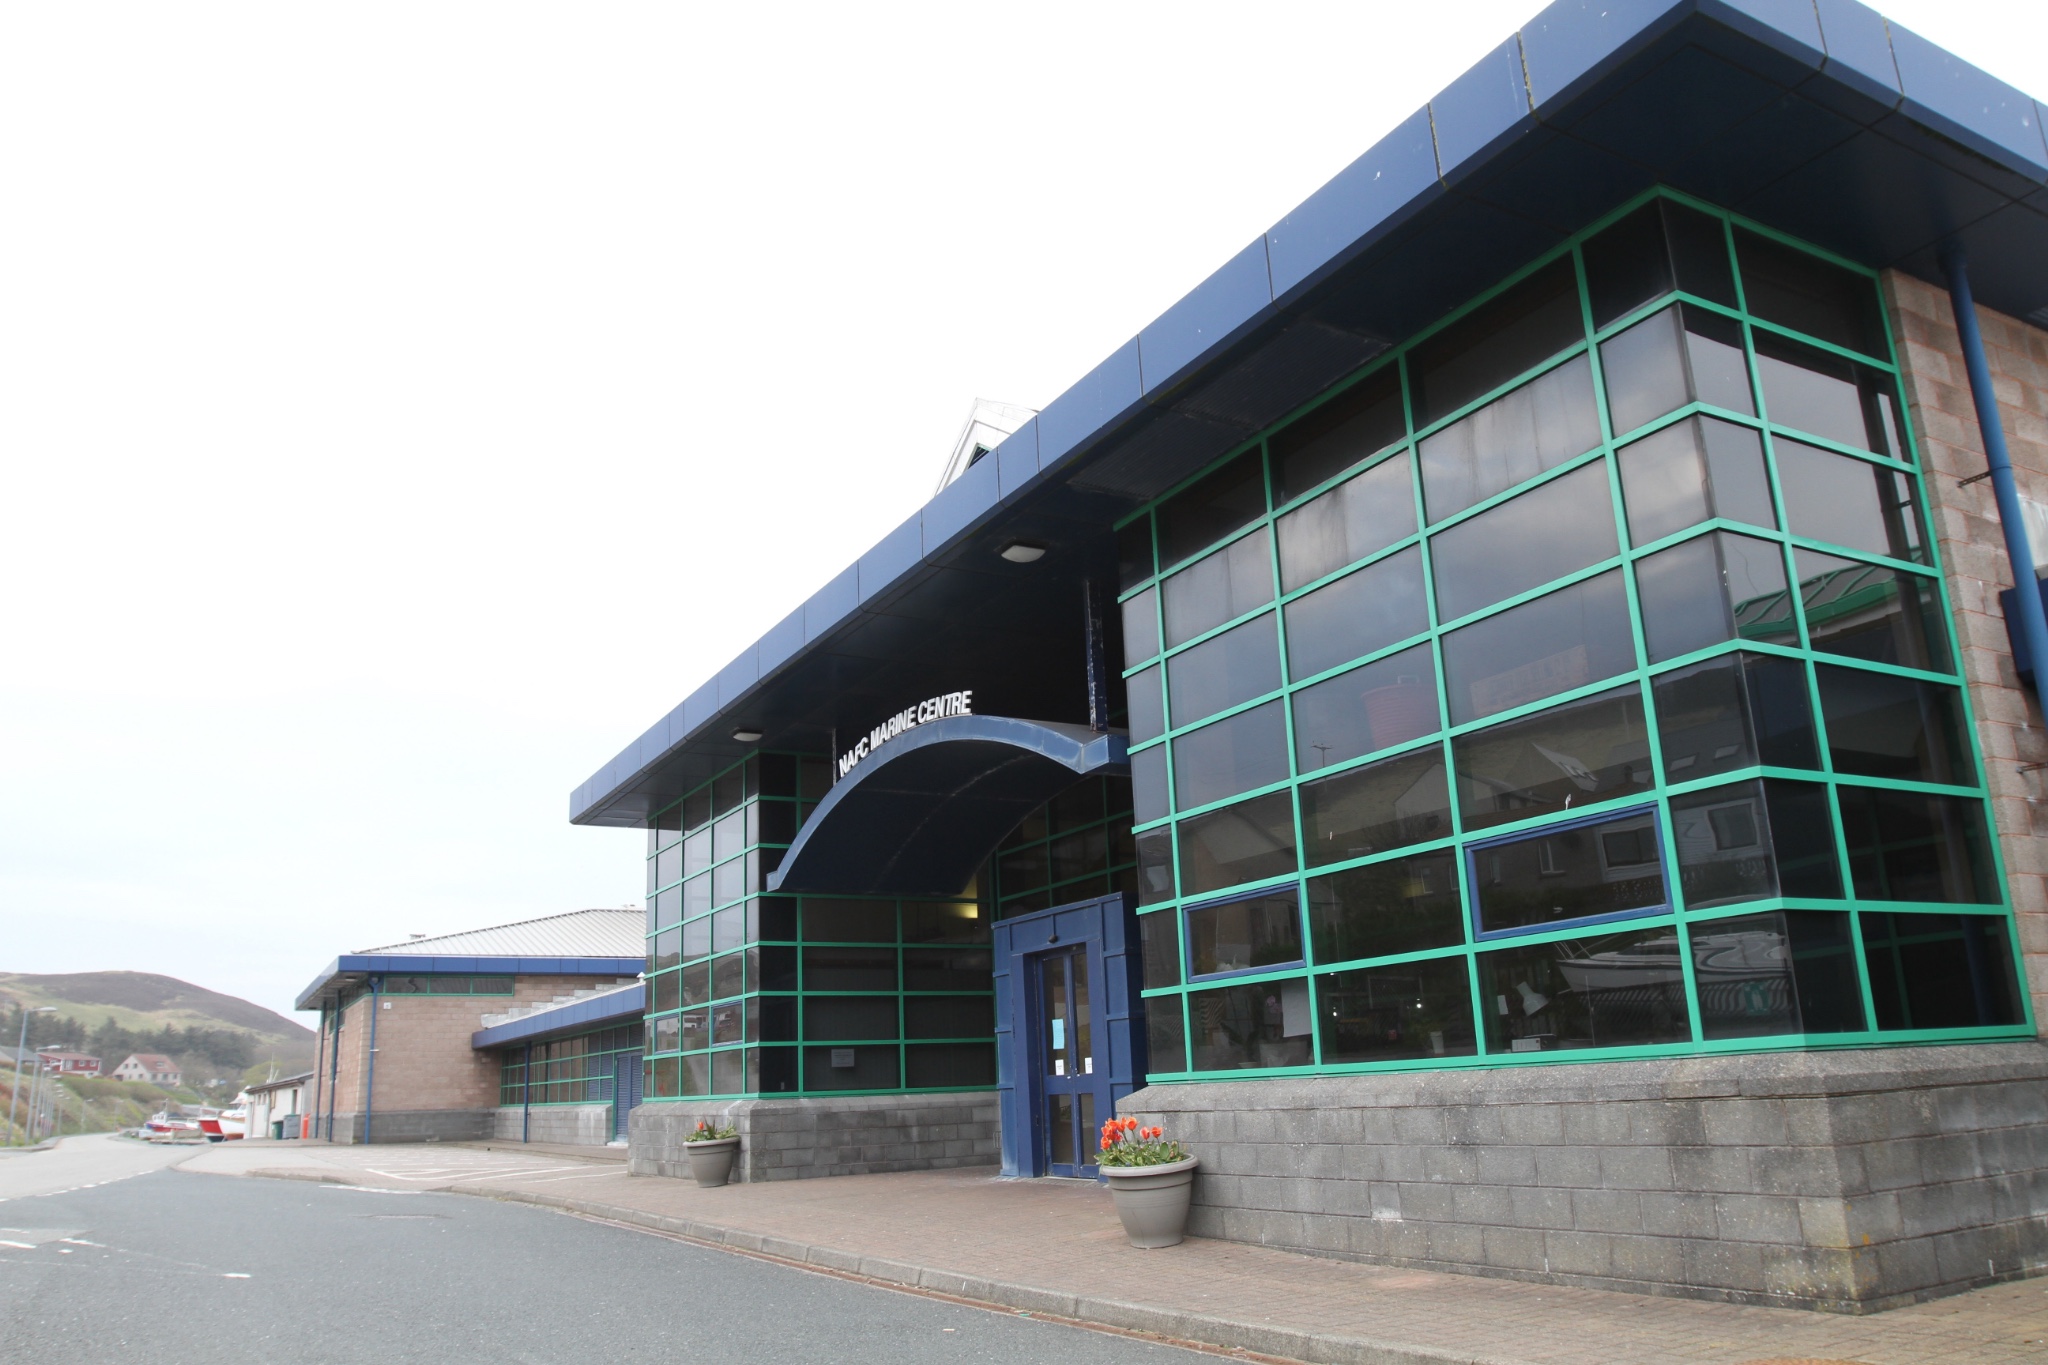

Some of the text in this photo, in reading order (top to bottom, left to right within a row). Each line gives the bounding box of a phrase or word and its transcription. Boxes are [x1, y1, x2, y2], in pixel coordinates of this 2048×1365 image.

[838, 690, 972, 778] NAFC MARINE CENTRE
